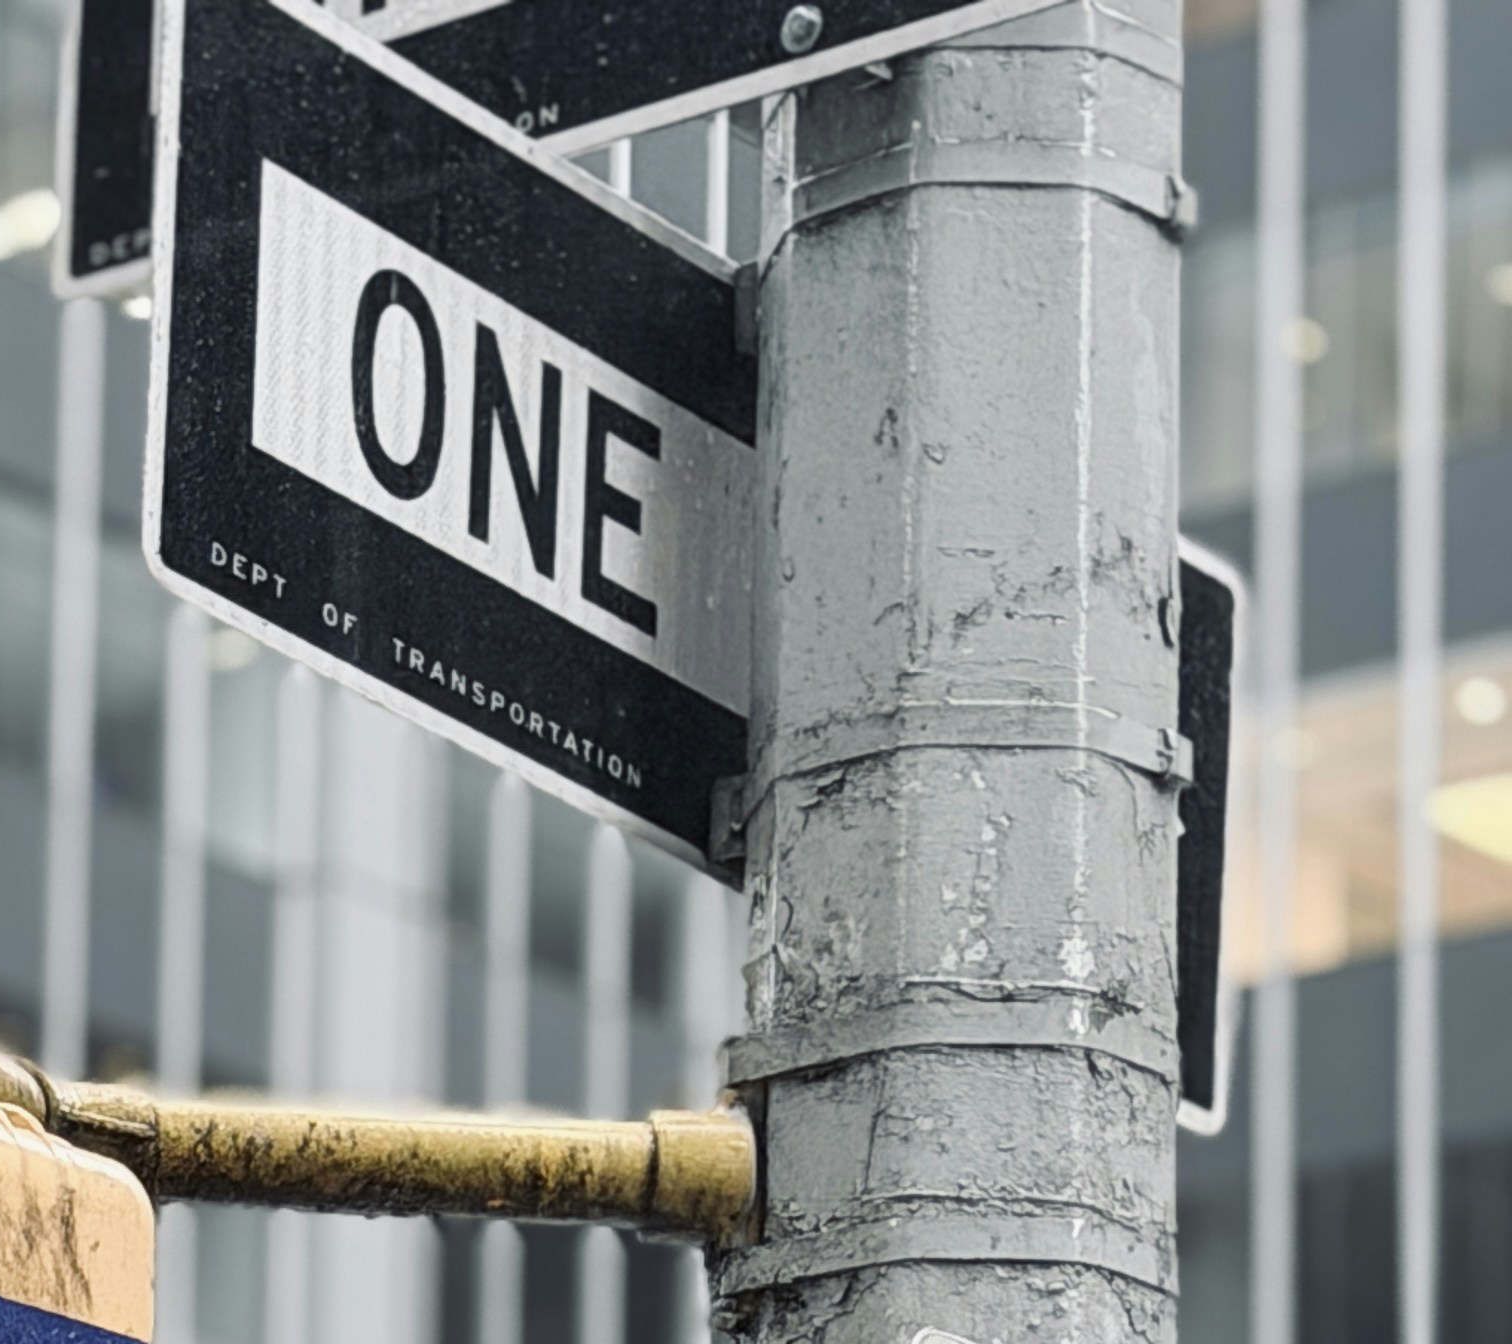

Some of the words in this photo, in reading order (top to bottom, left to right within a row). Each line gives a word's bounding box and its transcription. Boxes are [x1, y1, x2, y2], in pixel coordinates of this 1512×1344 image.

[351, 268, 661, 640] ONE
[211, 541, 287, 598] DEPT
[322, 602, 359, 635] OF
[393, 637, 643, 788] TRANSPORTATION
